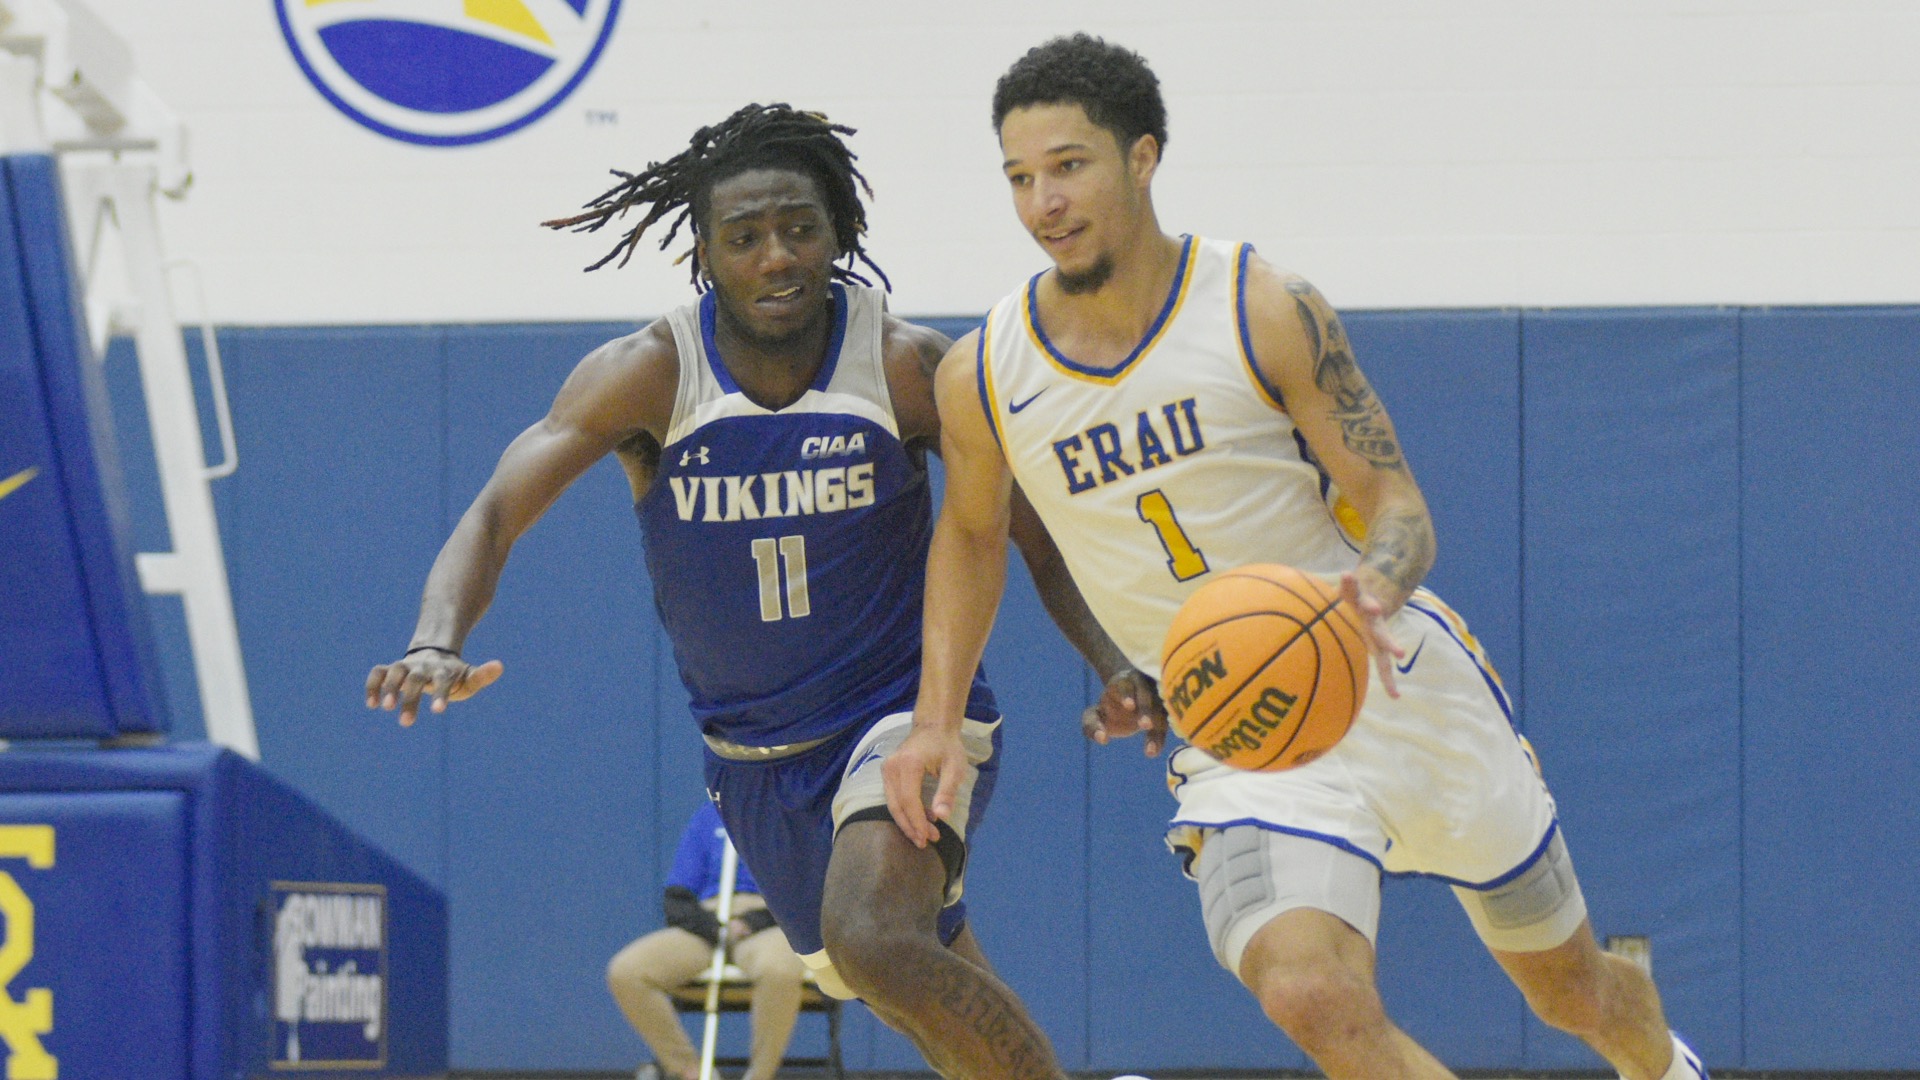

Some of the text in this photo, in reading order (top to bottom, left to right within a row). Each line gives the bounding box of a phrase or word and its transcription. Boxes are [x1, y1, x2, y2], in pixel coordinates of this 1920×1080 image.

[801, 433, 866, 459] CIAA
[1053, 398, 1205, 495] ERAU
[669, 462, 875, 522] VIKINGS
[1136, 488, 1210, 583] 1
[751, 535, 810, 622] 11
[1211, 686, 1298, 761] Wilso
